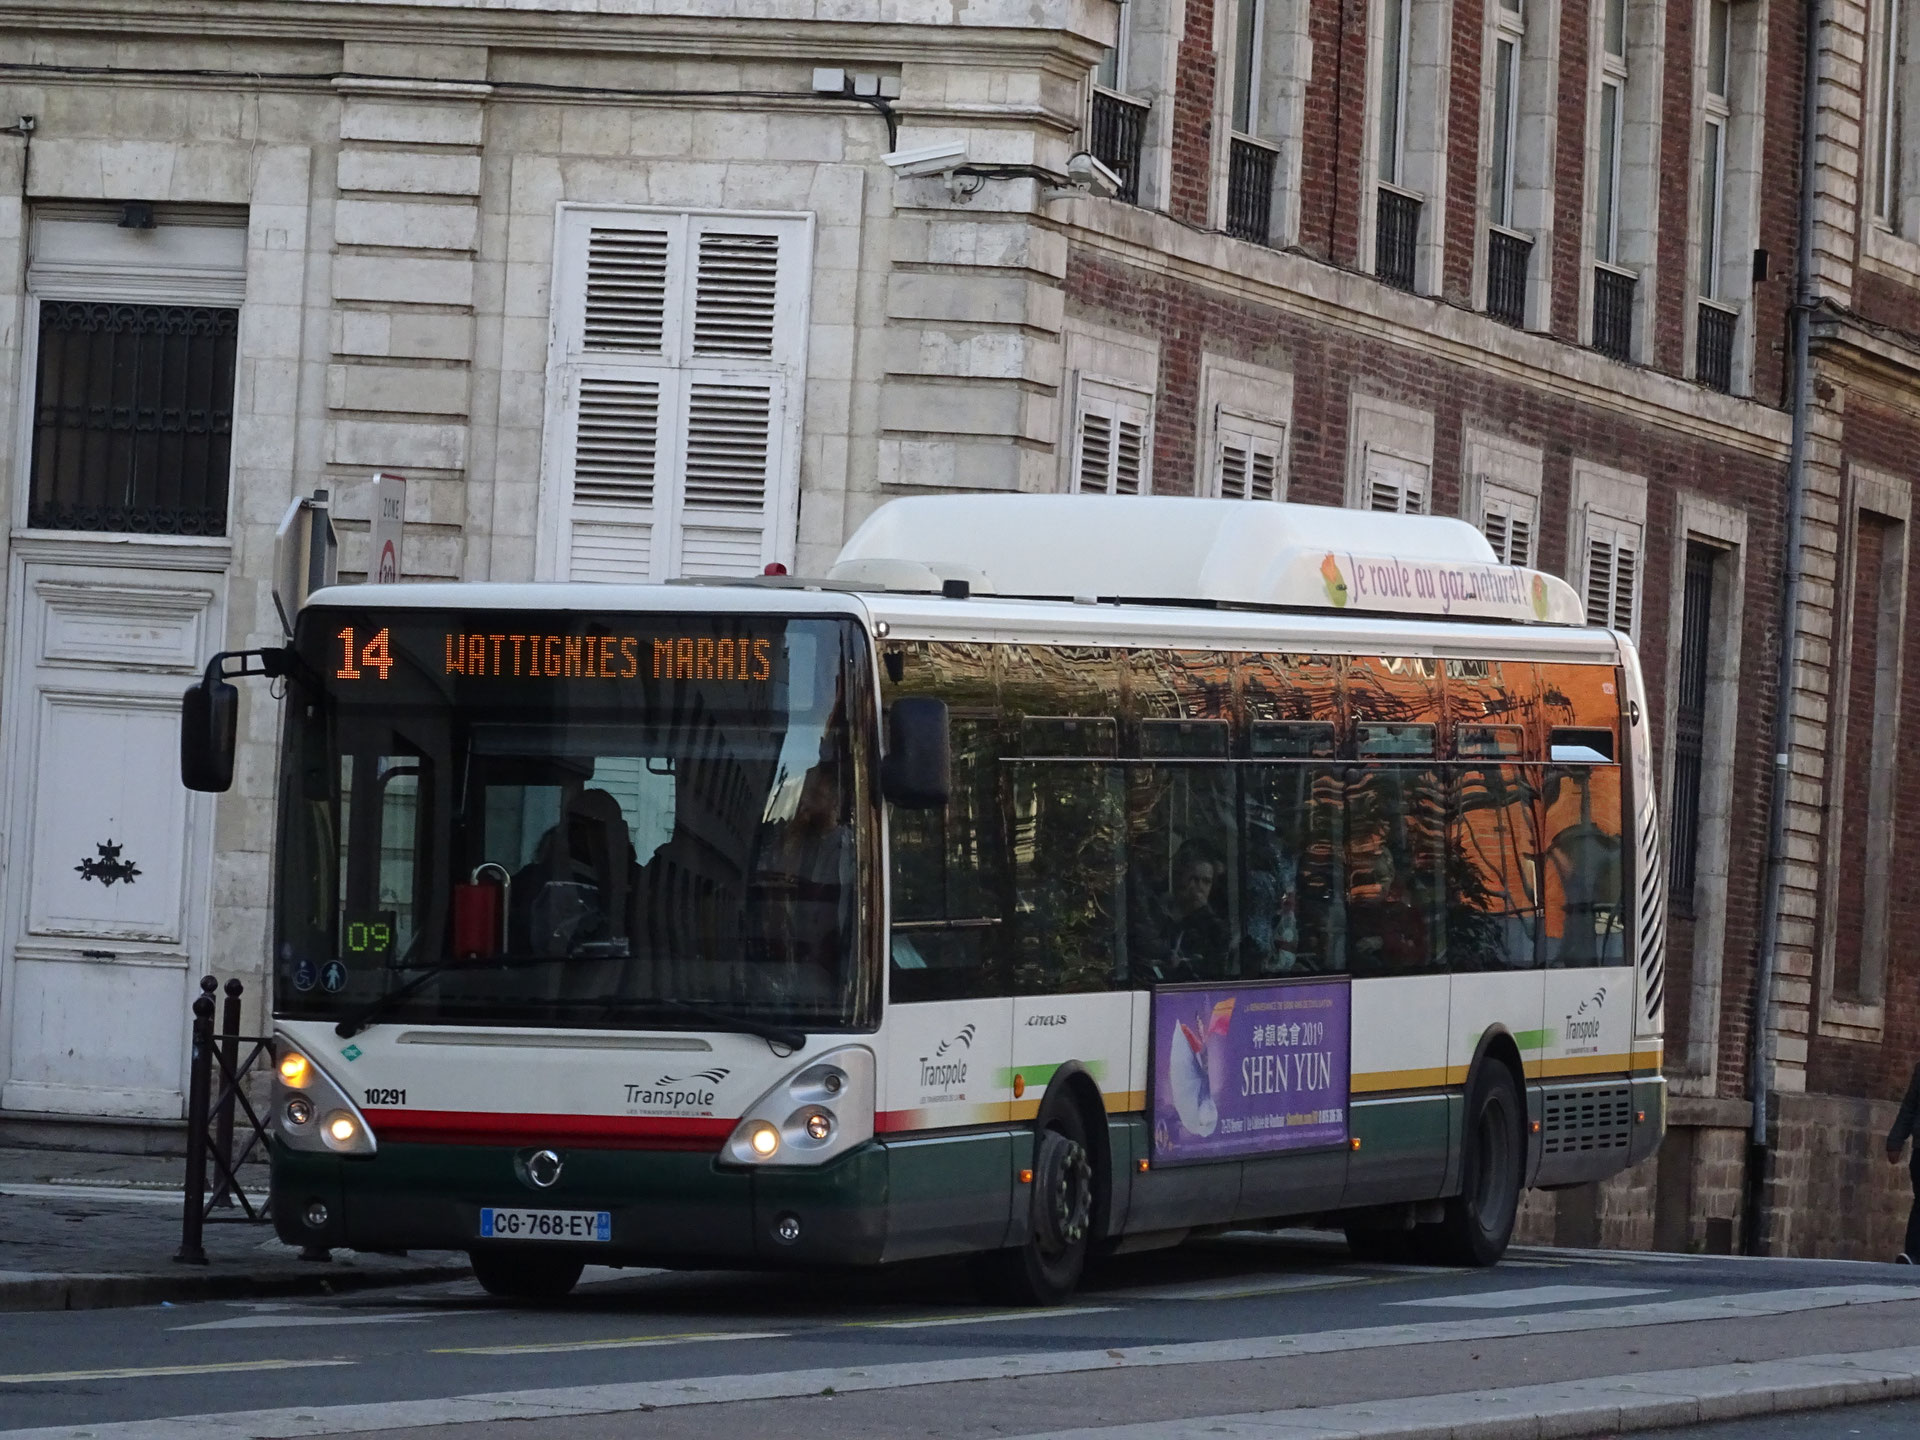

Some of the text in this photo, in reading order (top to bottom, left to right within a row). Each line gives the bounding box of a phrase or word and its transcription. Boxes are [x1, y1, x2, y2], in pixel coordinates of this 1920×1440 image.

[383, 497, 400, 520] ZONE
[1346, 552, 1367, 603] Je
[1369, 555, 1411, 599] roule
[1414, 567, 1436, 599] au
[1439, 569, 1468, 614] gaz
[334, 627, 394, 680] 14
[445, 633, 772, 681] WATTIGNIES MARAIS
[348, 922, 390, 952] 09
[1302, 1021, 1324, 1046] 2019
[1566, 1015, 1600, 1046] Transpole
[919, 1057, 968, 1093] Transpole
[1242, 1052, 1332, 1097] SHEN YUN
[364, 1088, 406, 1105] 10291
[624, 1084, 715, 1109] Transpole
[494, 1213, 595, 1236] CG-768-EY
